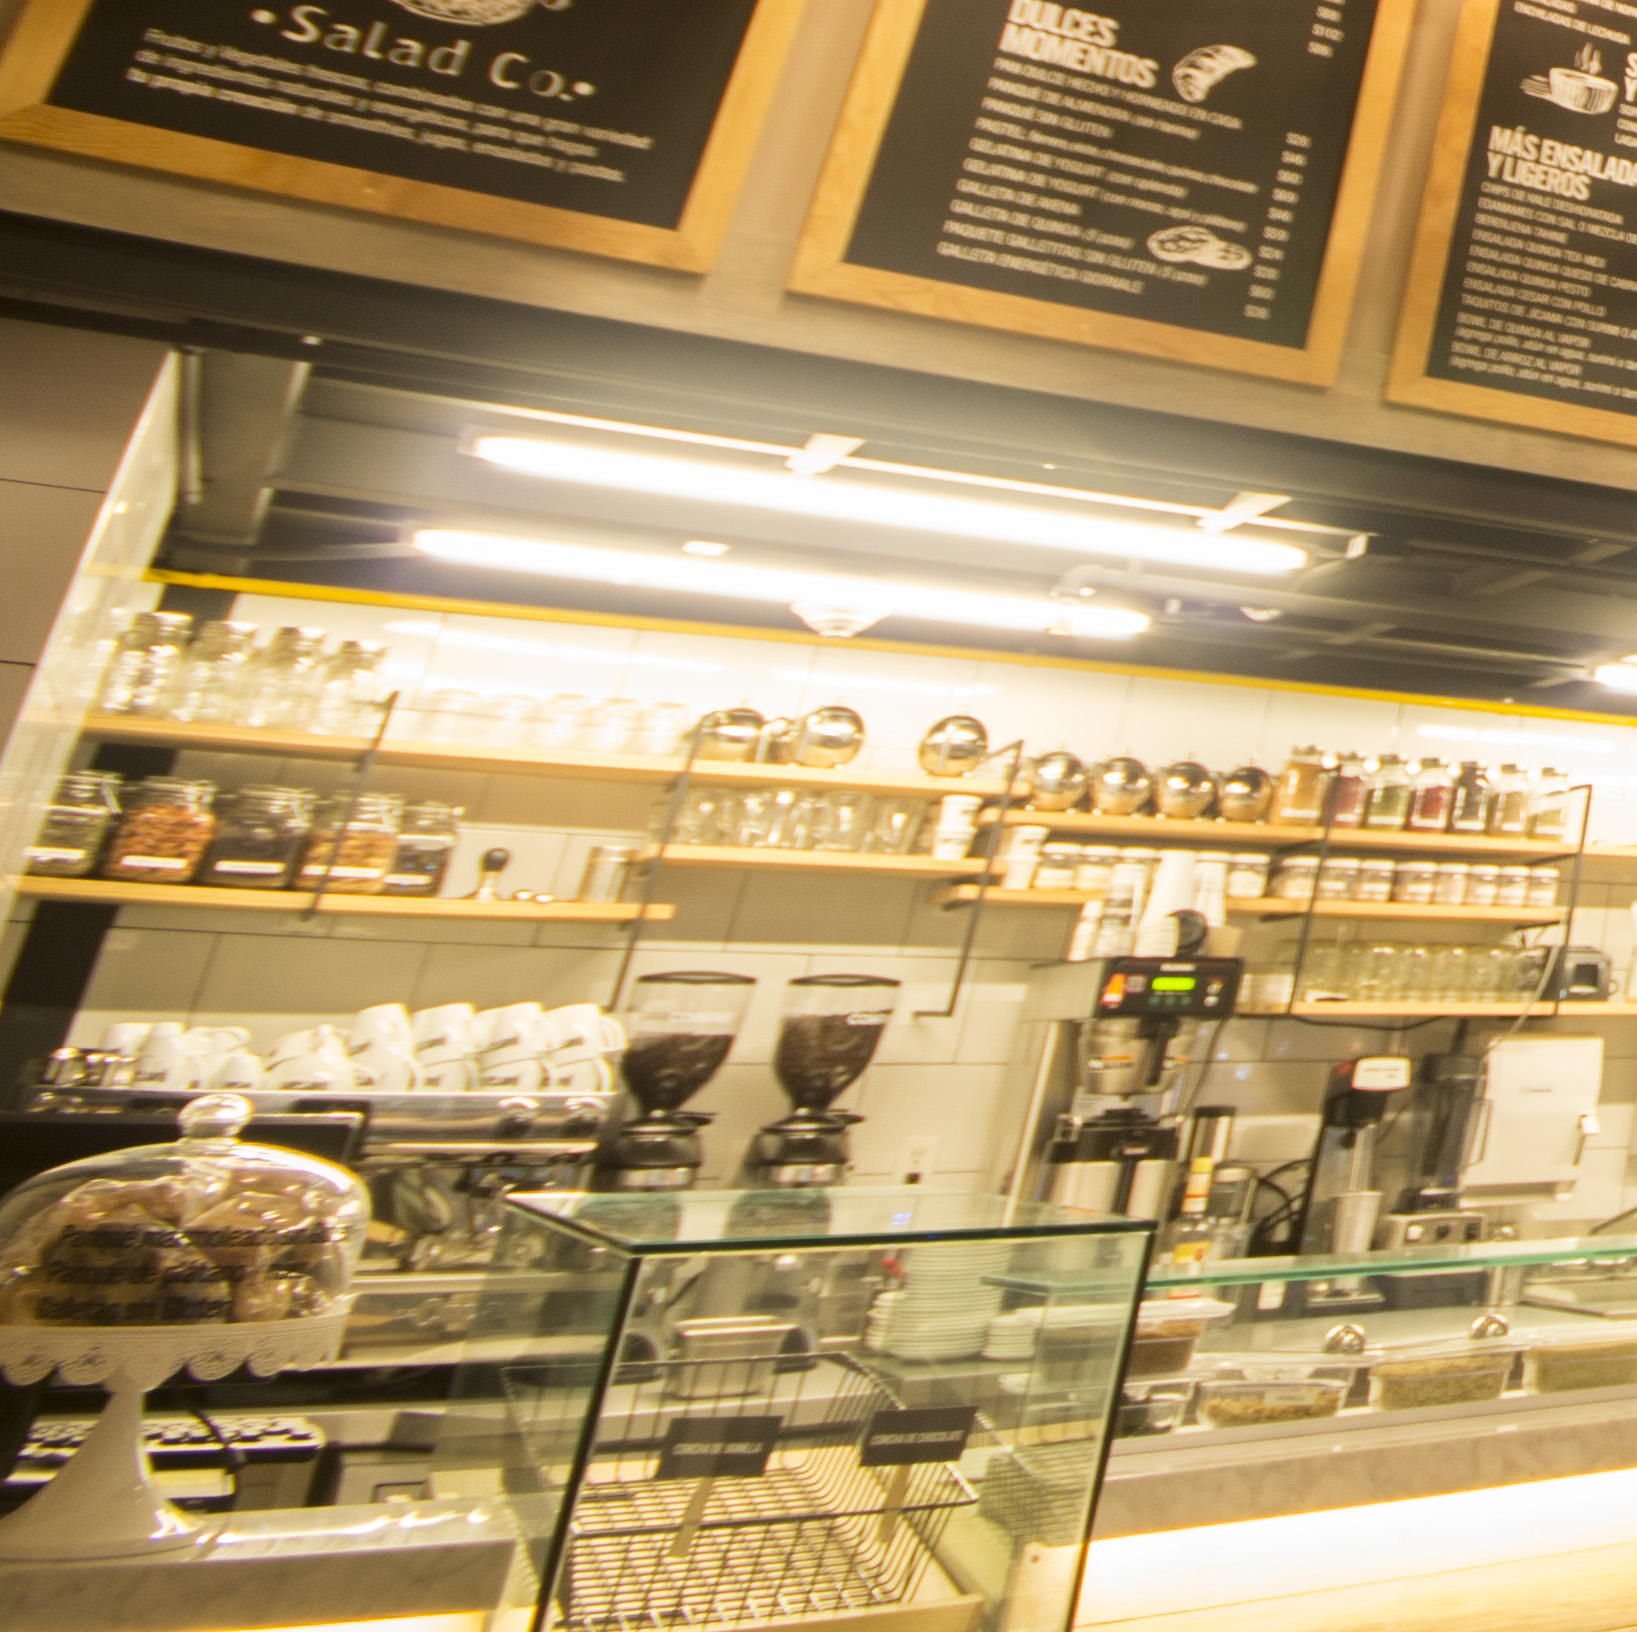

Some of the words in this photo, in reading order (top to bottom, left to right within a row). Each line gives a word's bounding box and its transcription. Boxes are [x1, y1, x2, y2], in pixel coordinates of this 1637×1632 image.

[280, 2, 472, 77] Salad
[997, 21, 1161, 90] MOMENTOS
[1487, 118, 1542, 162] MÁS
[1482, 150, 1505, 181] Y
[1501, 155, 1593, 203] LIGEROS
